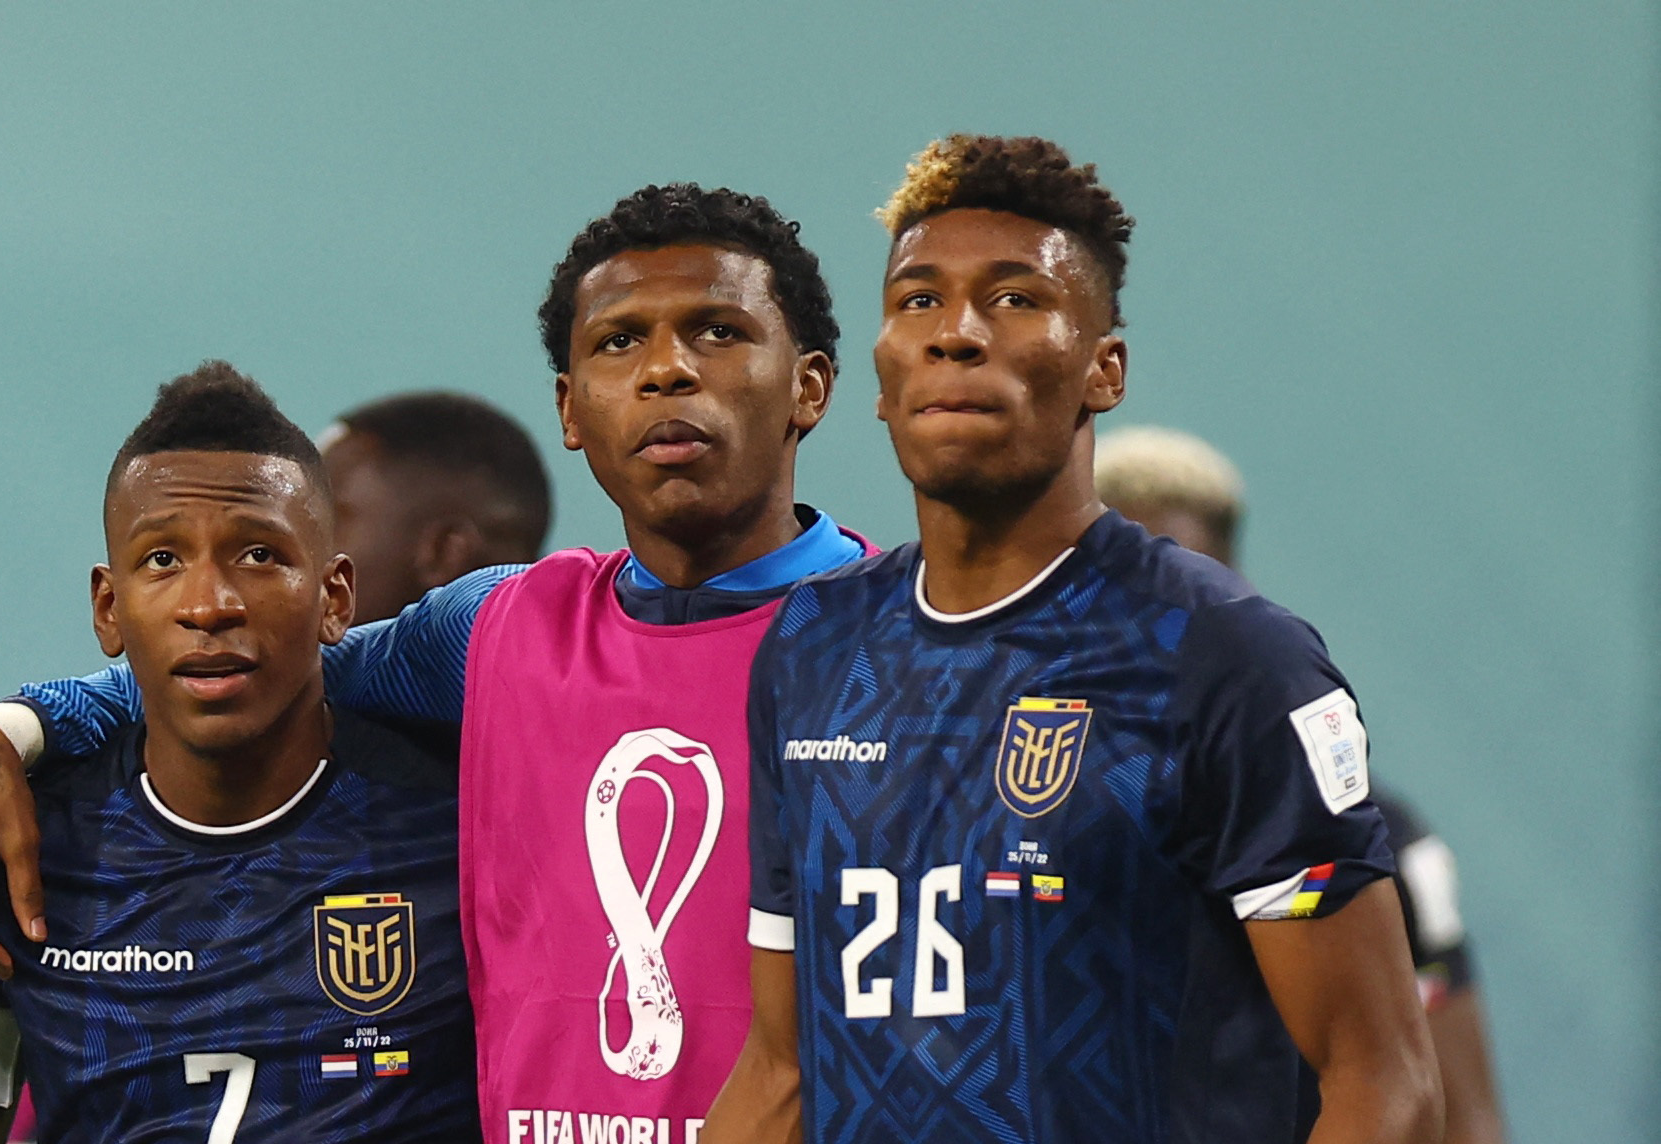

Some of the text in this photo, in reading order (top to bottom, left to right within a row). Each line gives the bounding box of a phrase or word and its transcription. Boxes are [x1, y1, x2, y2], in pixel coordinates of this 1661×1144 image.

[784, 735, 887, 763] marathon
[841, 864, 966, 1019] 26
[40, 945, 194, 972] marathon
[356, 1026, 378, 1037] DOHA
